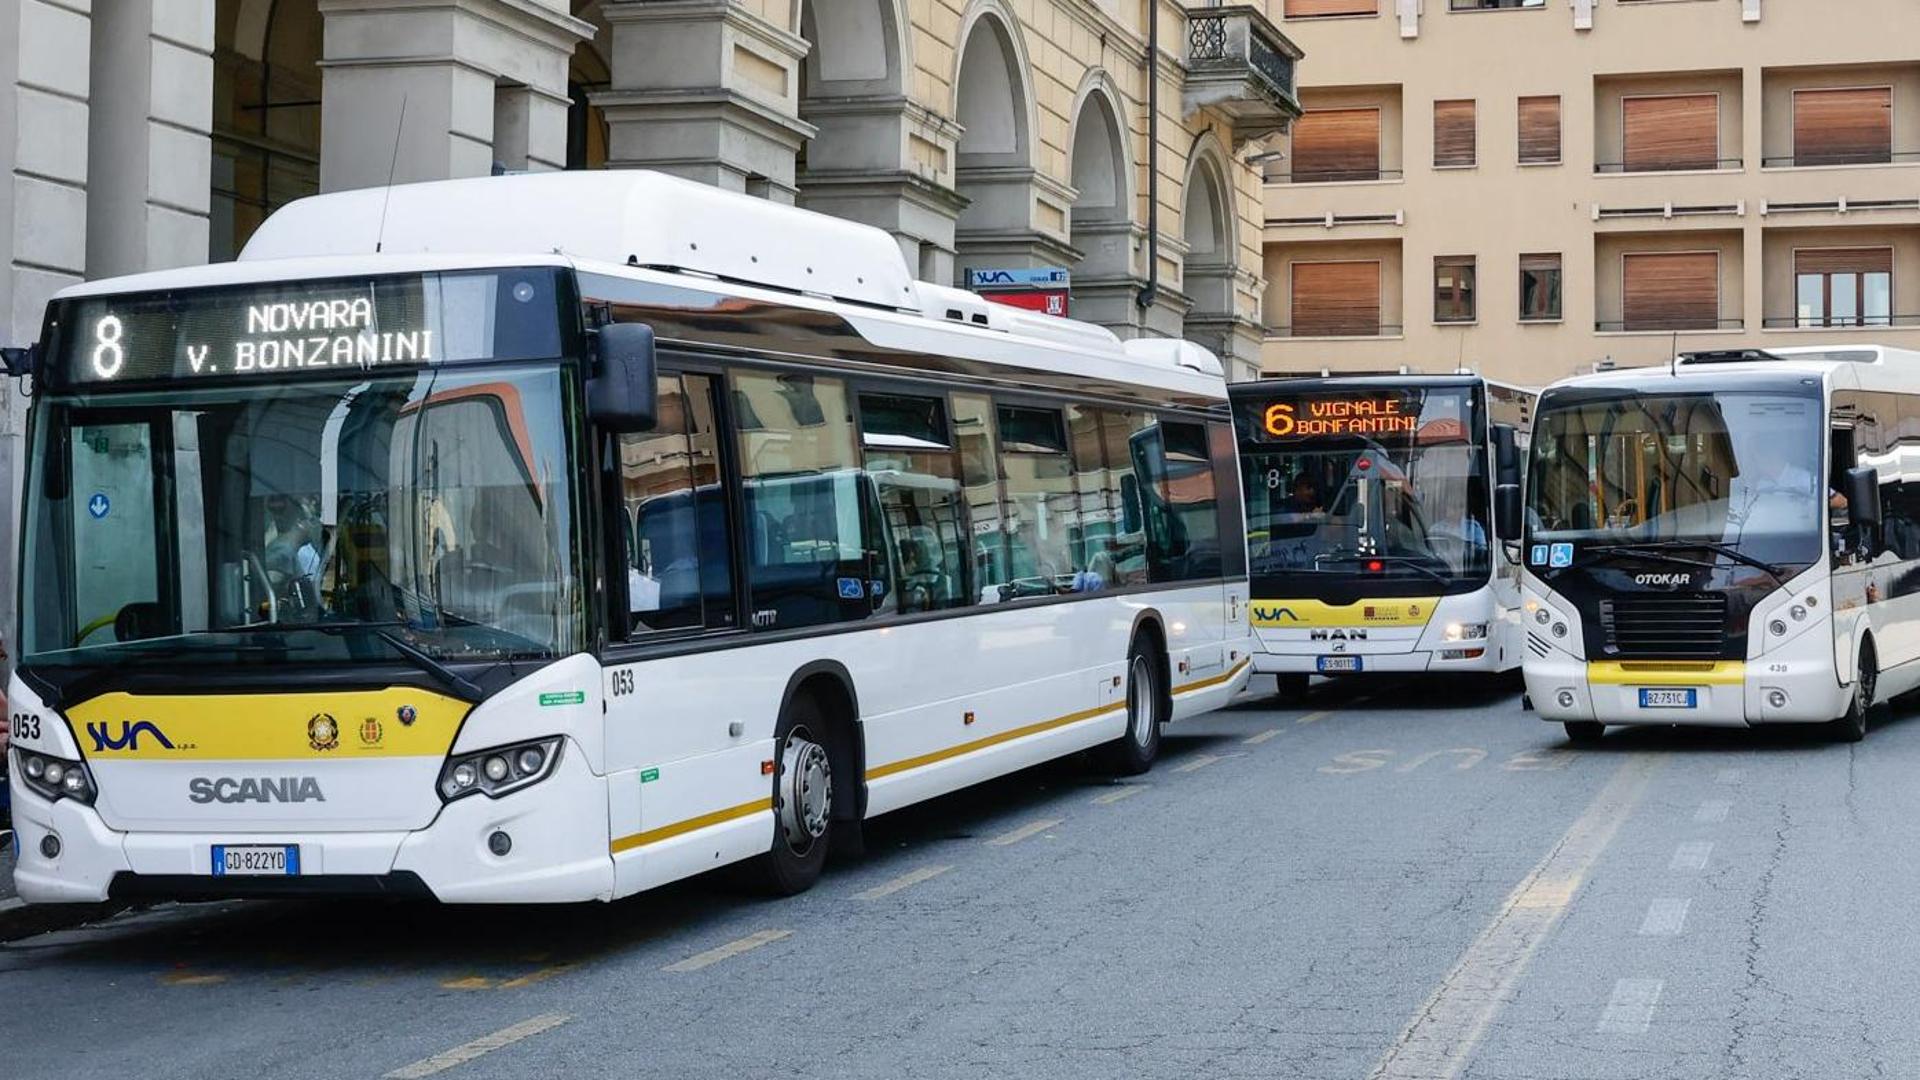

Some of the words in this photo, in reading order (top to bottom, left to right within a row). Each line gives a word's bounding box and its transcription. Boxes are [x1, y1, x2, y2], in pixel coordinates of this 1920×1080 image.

[249, 298, 371, 333] NOVARA
[93, 315, 123, 378] 8
[235, 330, 433, 371] BONZANINI
[1265, 404, 1294, 435] 6
[1311, 400, 1400, 416] VIGNALE
[1296, 416, 1417, 435] BONFANTINI
[1635, 573, 1690, 584] OTOKAR
[1310, 629, 1367, 640] MAN
[612, 669, 635, 697] 053
[13, 714, 41, 740] 053
[189, 777, 327, 804] SCANIA
